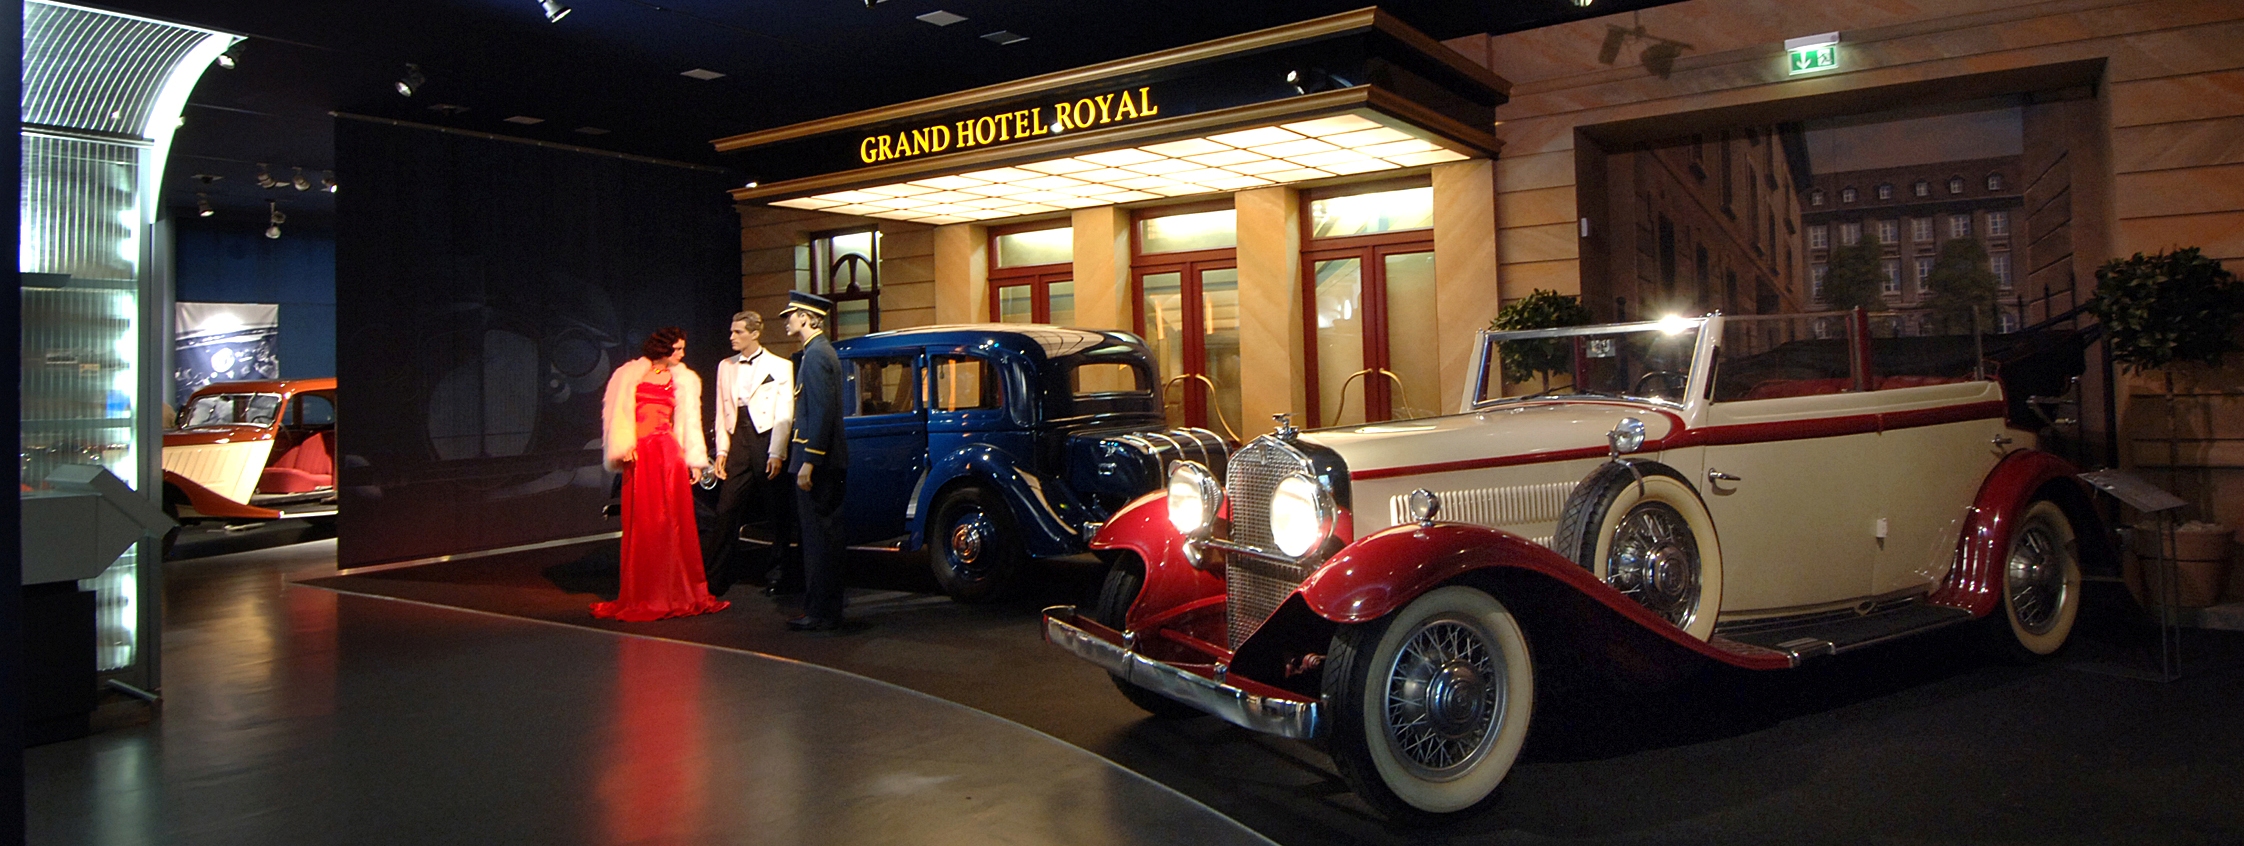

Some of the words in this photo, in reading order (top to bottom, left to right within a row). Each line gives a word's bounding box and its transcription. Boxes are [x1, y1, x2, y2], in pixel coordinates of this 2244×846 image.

[860, 125, 950, 164] GRAND
[956, 107, 1048, 148] HOTEL
[1055, 87, 1158, 130] ROYAL
